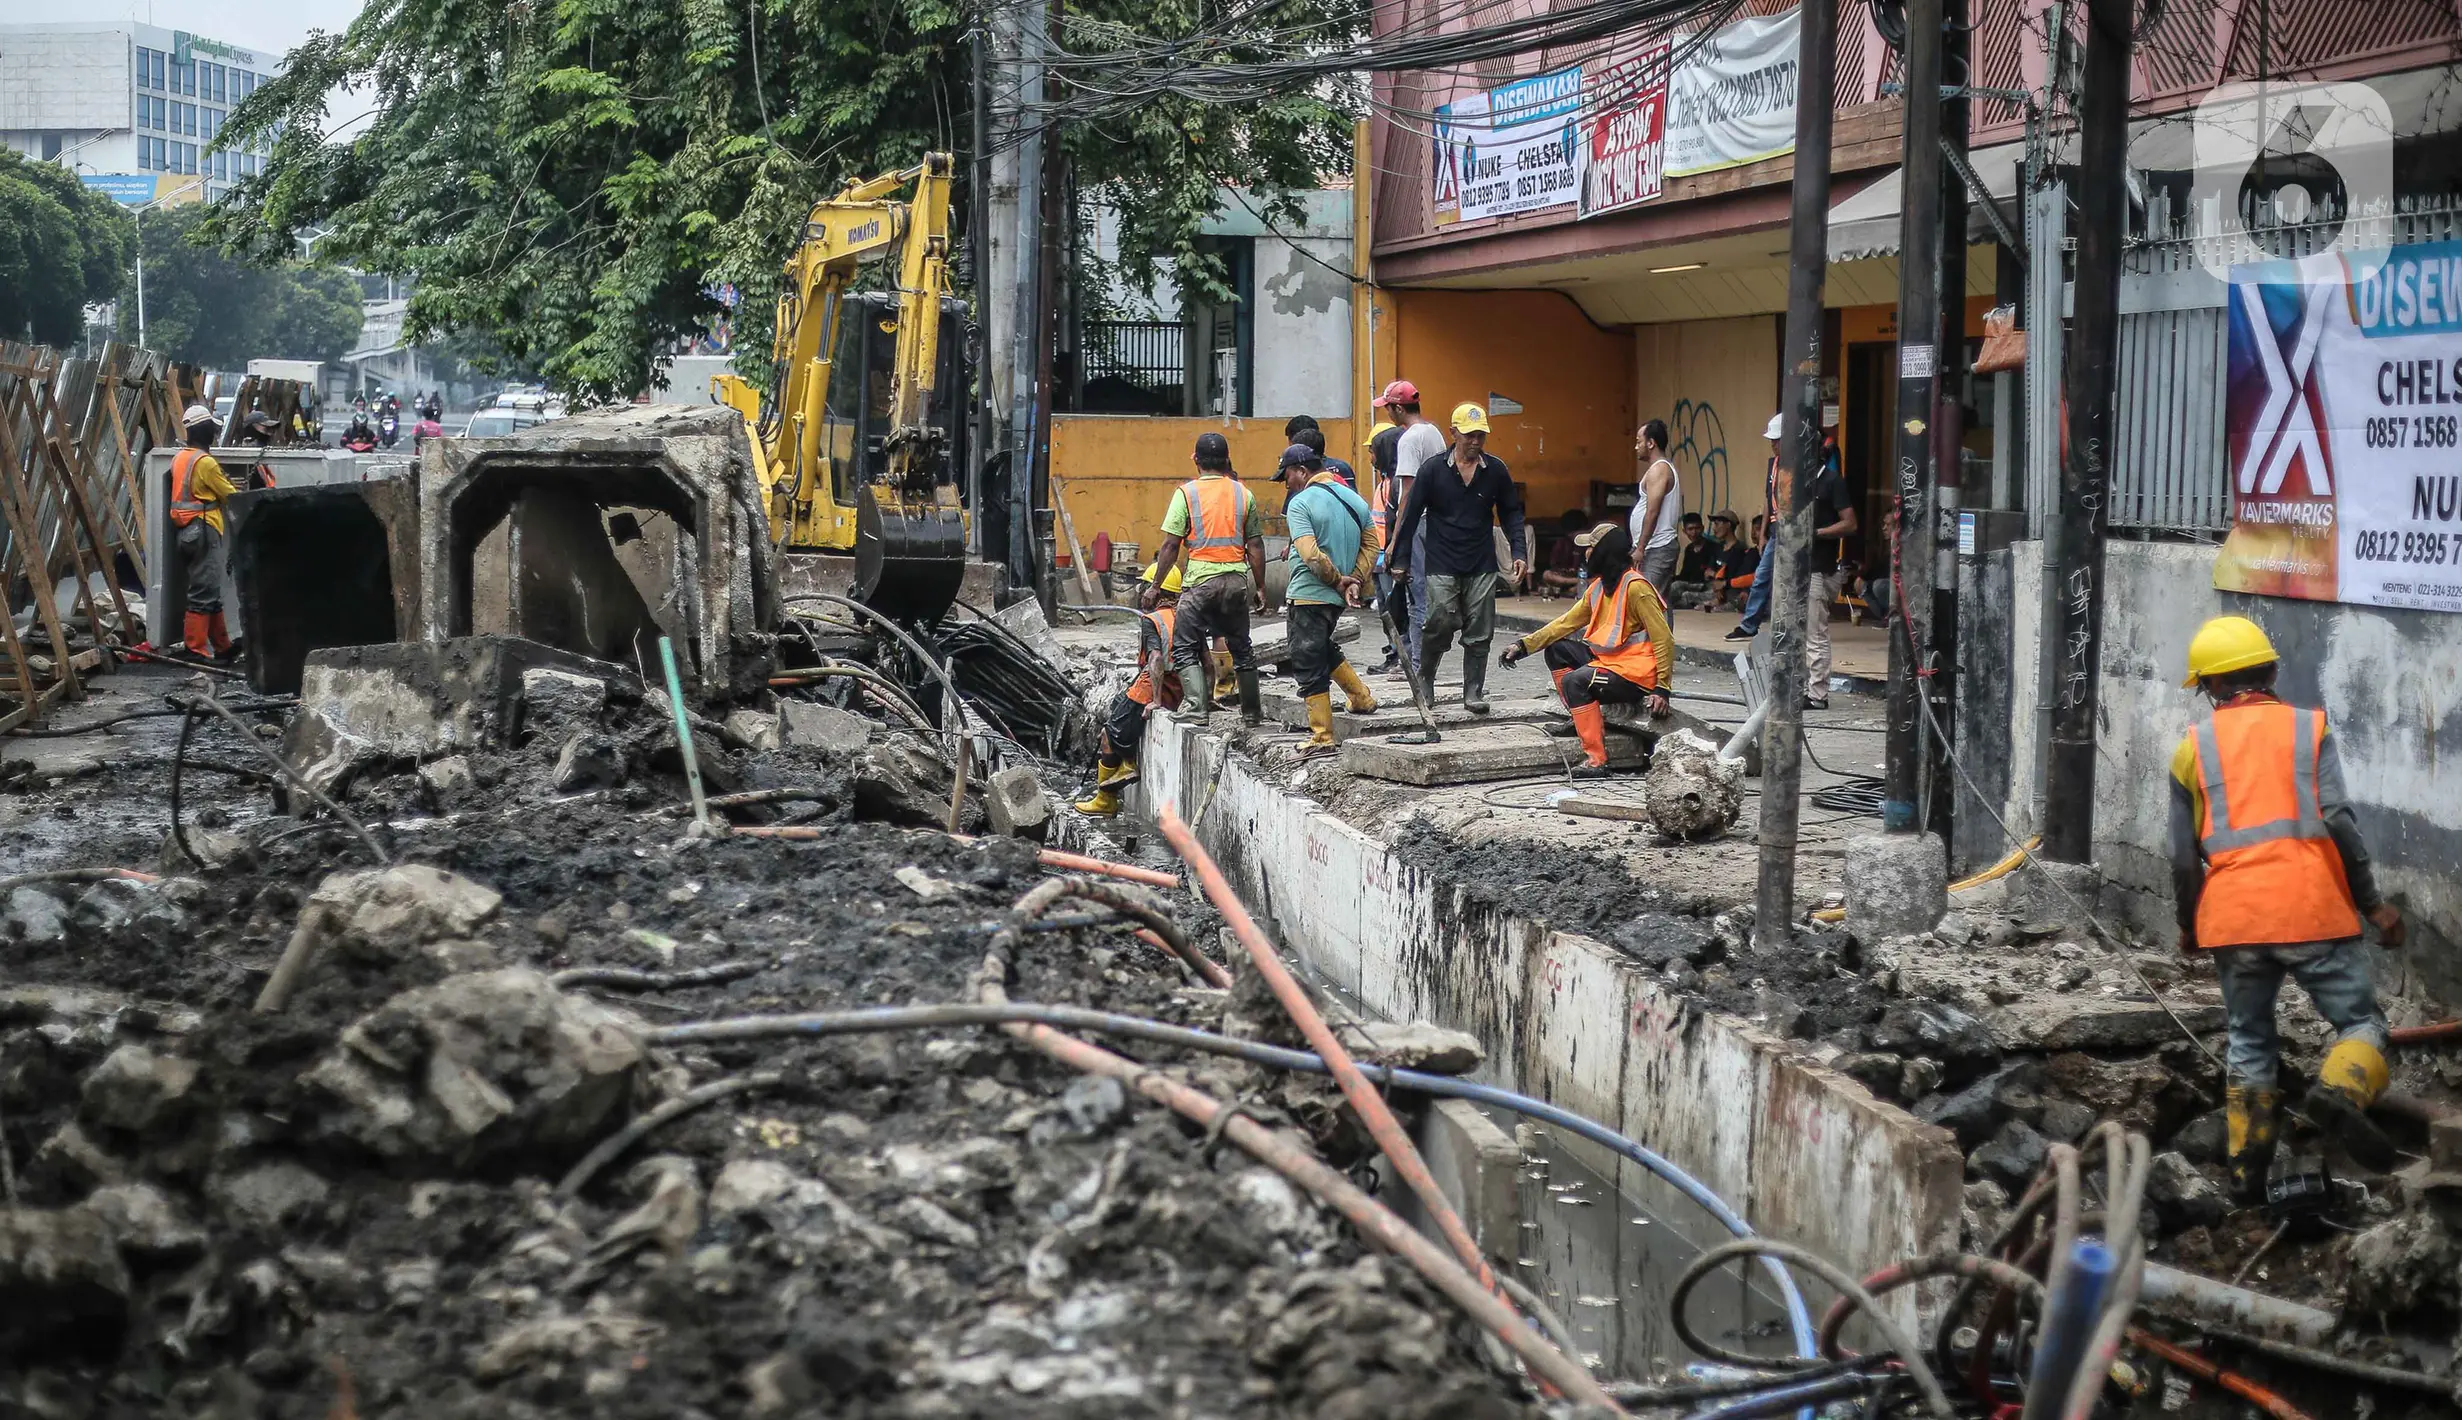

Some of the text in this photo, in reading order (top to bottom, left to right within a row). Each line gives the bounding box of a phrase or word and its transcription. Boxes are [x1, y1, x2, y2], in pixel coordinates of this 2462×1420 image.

[1495, 71, 1579, 124] DISEWAKAN
[1478, 155, 1501, 180] NUKE
[1518, 141, 1563, 171] CHELSEA
[1517, 175, 1536, 197] 0857
[1538, 171, 1557, 193] 1568
[847, 217, 880, 246] KOMATSU
[2366, 415, 2458, 449] 0857 1568
[2239, 501, 2334, 526] XAVIERMARKS
[2355, 529, 2400, 562] 0812
[2402, 530, 2449, 565] 9395
[2382, 582, 2412, 594] MENTENG
